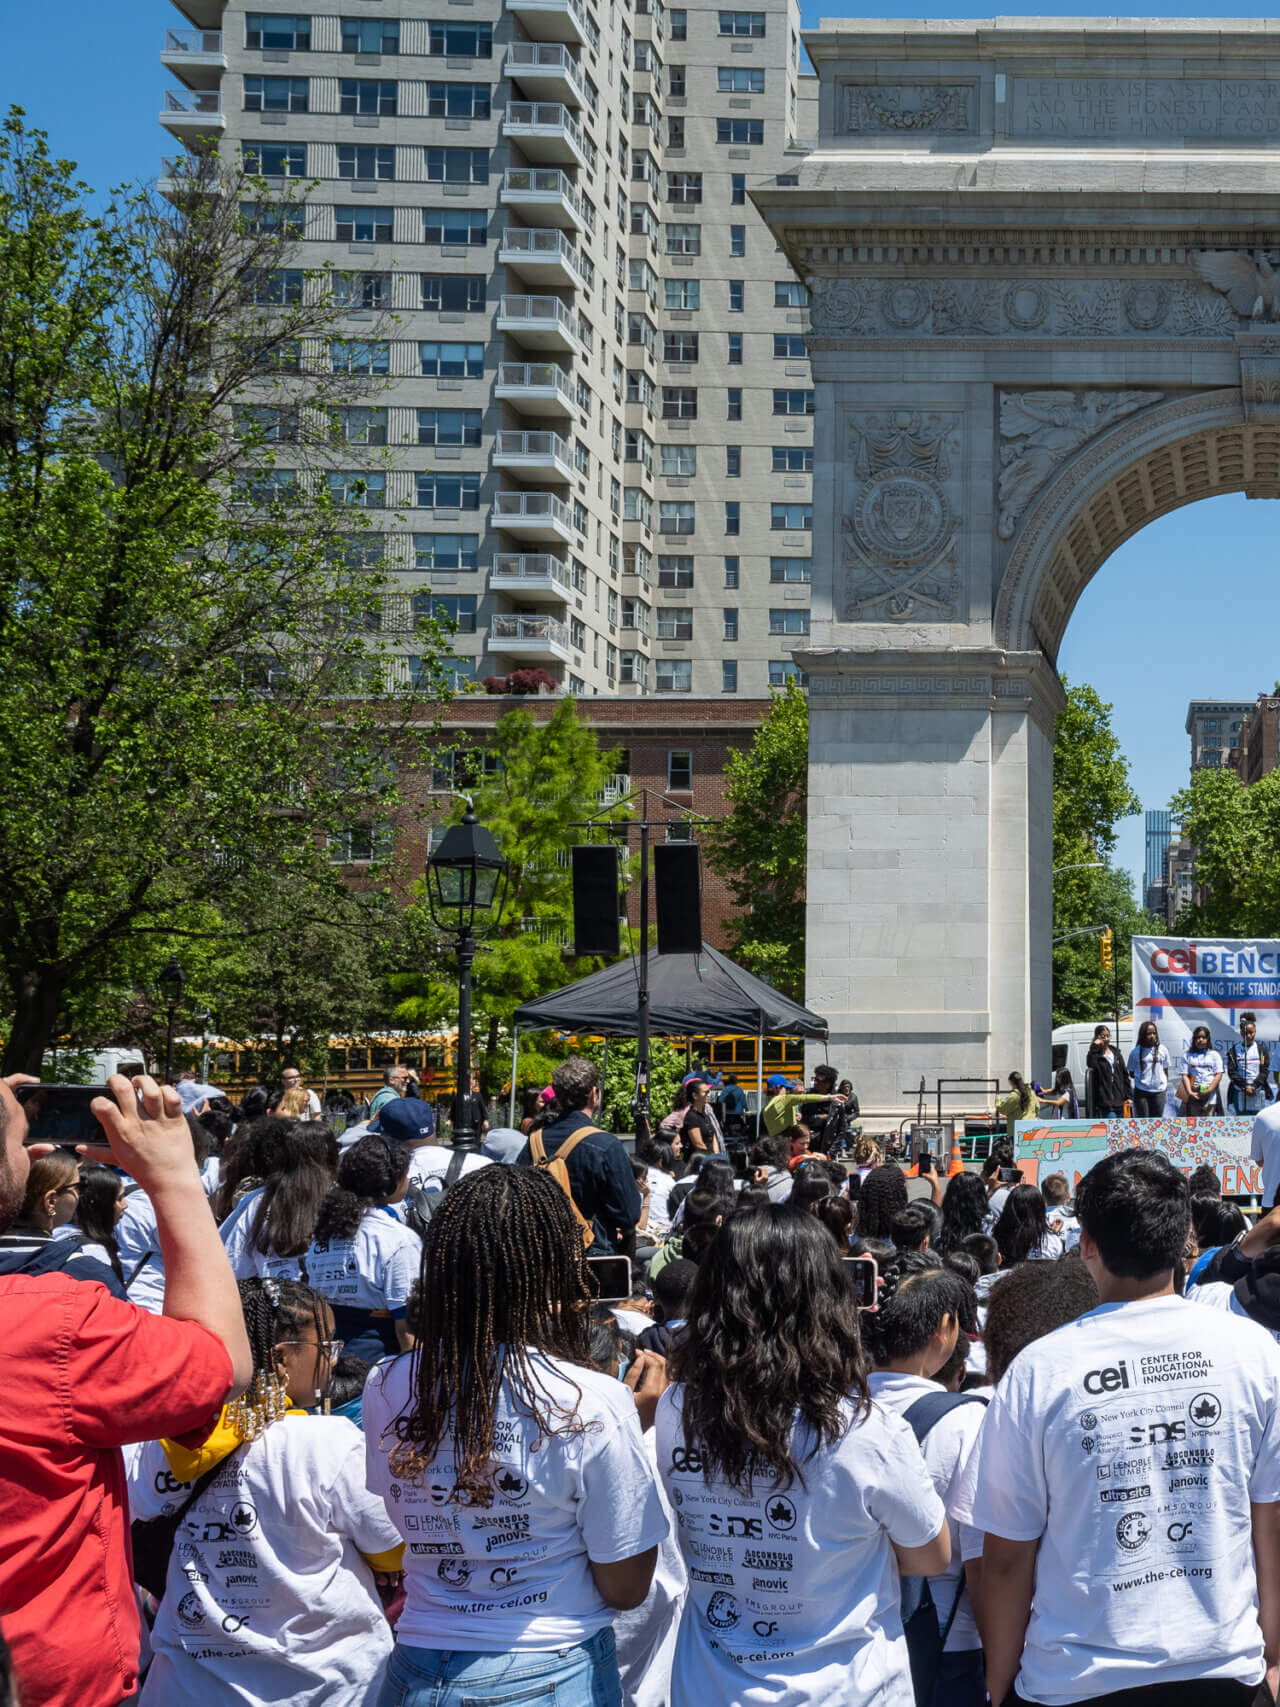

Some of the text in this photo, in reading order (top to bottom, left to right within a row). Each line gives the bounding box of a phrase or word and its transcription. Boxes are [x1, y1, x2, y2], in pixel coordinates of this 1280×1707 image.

[1026, 83, 1063, 97] LET
[1071, 82, 1091, 97] US
[1026, 100, 1066, 114] AND
[1076, 101, 1115, 114] THE
[1127, 101, 1209, 115] HONEST
[1222, 102, 1266, 116] CAN
[1079, 117, 1118, 130] THE
[1234, 118, 1279, 132] GOD
[1151, 944, 1197, 974] cei
[1154, 980, 1184, 993] YOUTH
[1187, 981, 1224, 995] SETTING
[1228, 982, 1244, 995] THE
[1083, 1351, 1202, 1395] cei CENTER FOR
[1142, 1360, 1214, 1375] EDUCATIONAL
[1143, 1369, 1208, 1384] INNOVATION
[1100, 1414, 1118, 1423] New
[1120, 1410, 1138, 1419] York
[1140, 1406, 1154, 1417] City
[1113, 1565, 1212, 1592] www.the-cei.org
